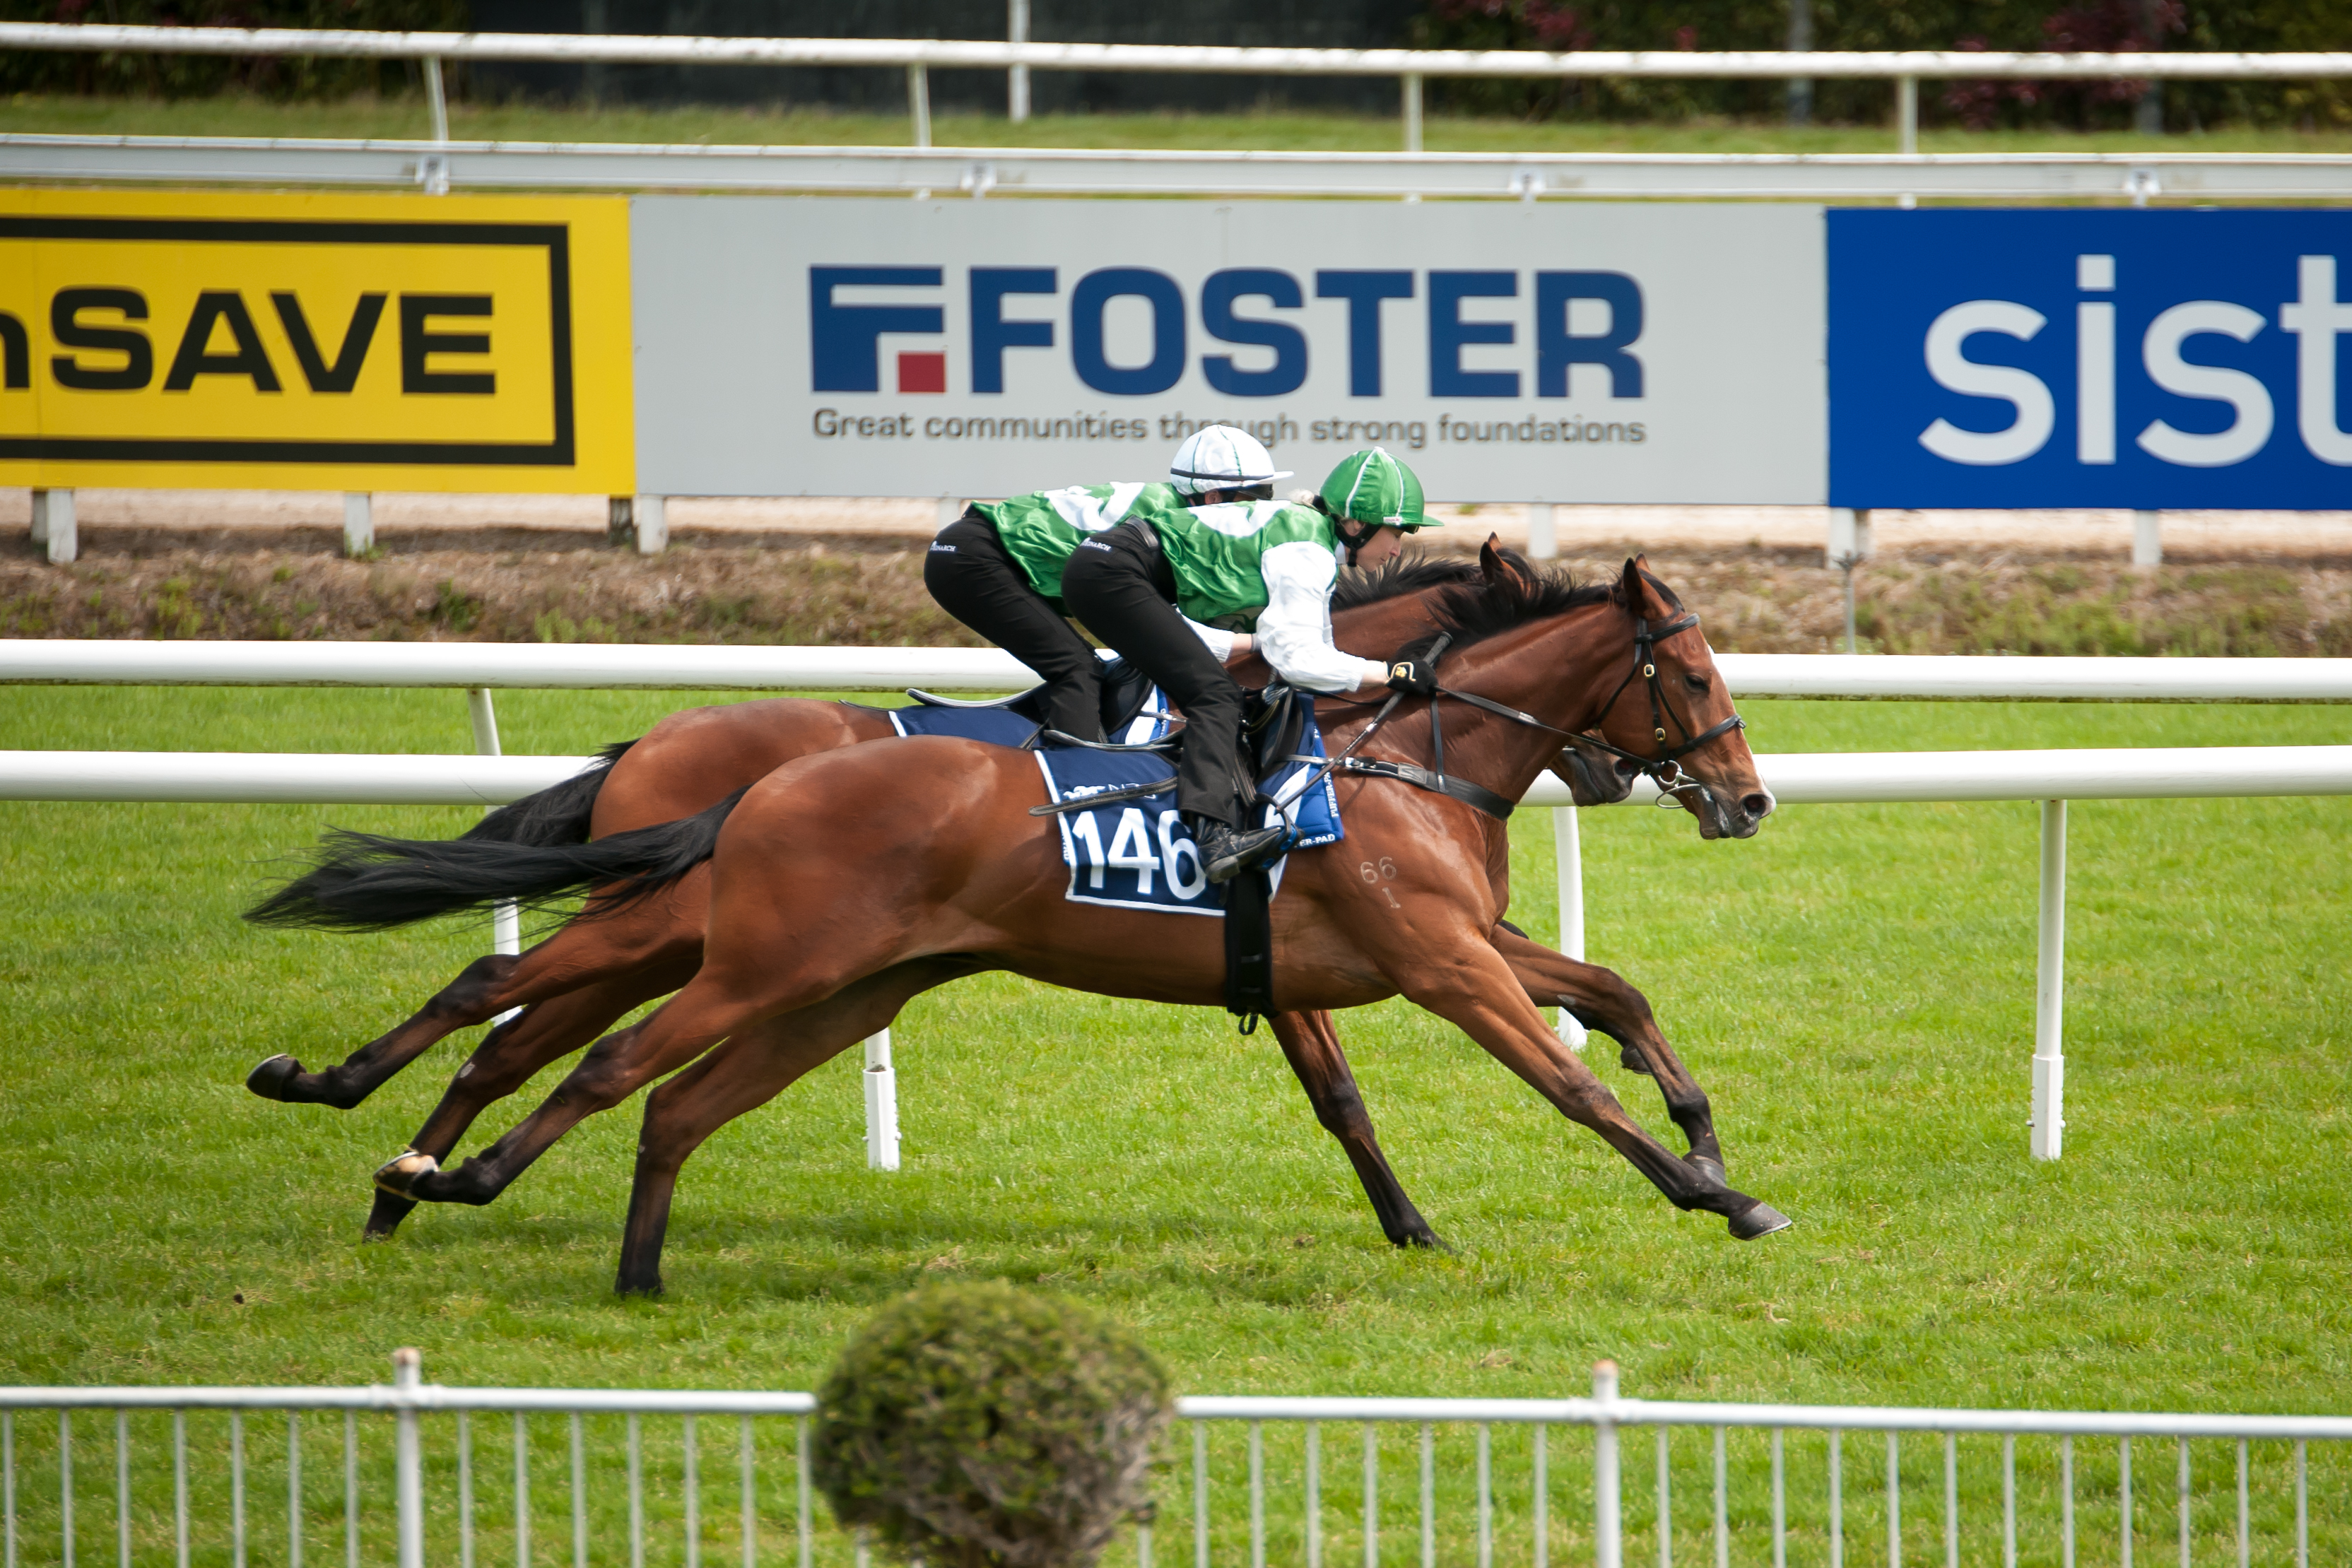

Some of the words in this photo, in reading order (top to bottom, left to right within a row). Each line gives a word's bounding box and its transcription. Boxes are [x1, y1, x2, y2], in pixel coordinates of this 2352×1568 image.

[968, 266, 1645, 399] FOSTER
[813, 408, 914, 440] Great
[925, 410, 1148, 442] communities
[1309, 415, 1426, 450] strong
[1438, 414, 1646, 444] foundations
[1071, 807, 1206, 900] 146
